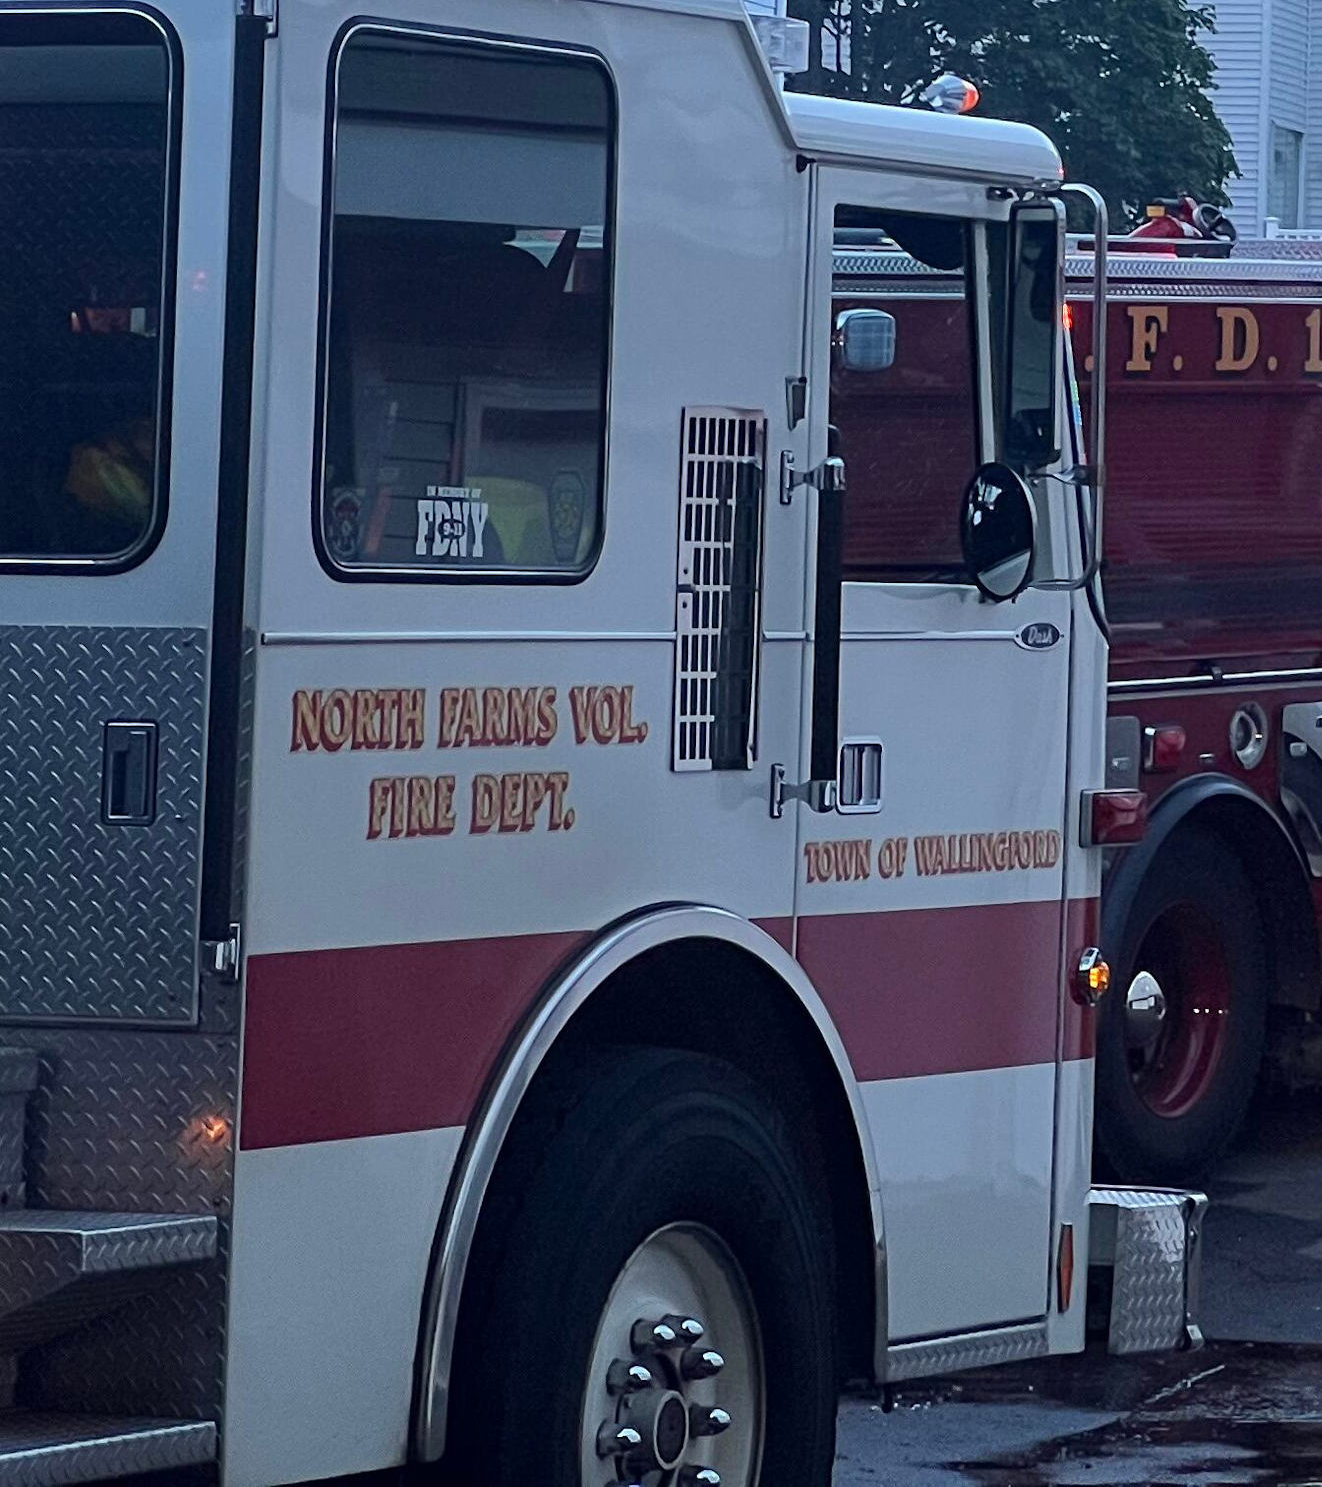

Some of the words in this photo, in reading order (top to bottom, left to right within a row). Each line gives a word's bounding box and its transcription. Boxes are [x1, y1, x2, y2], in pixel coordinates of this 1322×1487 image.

[415, 499, 488, 557] FDNY
[290, 688, 426, 752] NORTH
[437, 687, 557, 748] FARMS
[568, 685, 648, 744] VOL.
[366, 775, 456, 840] FIRE
[469, 772, 575, 834] DEPT.
[804, 839, 872, 884] TOWN
[878, 837, 908, 879] OF
[914, 829, 1061, 876] WALLINGFORD
